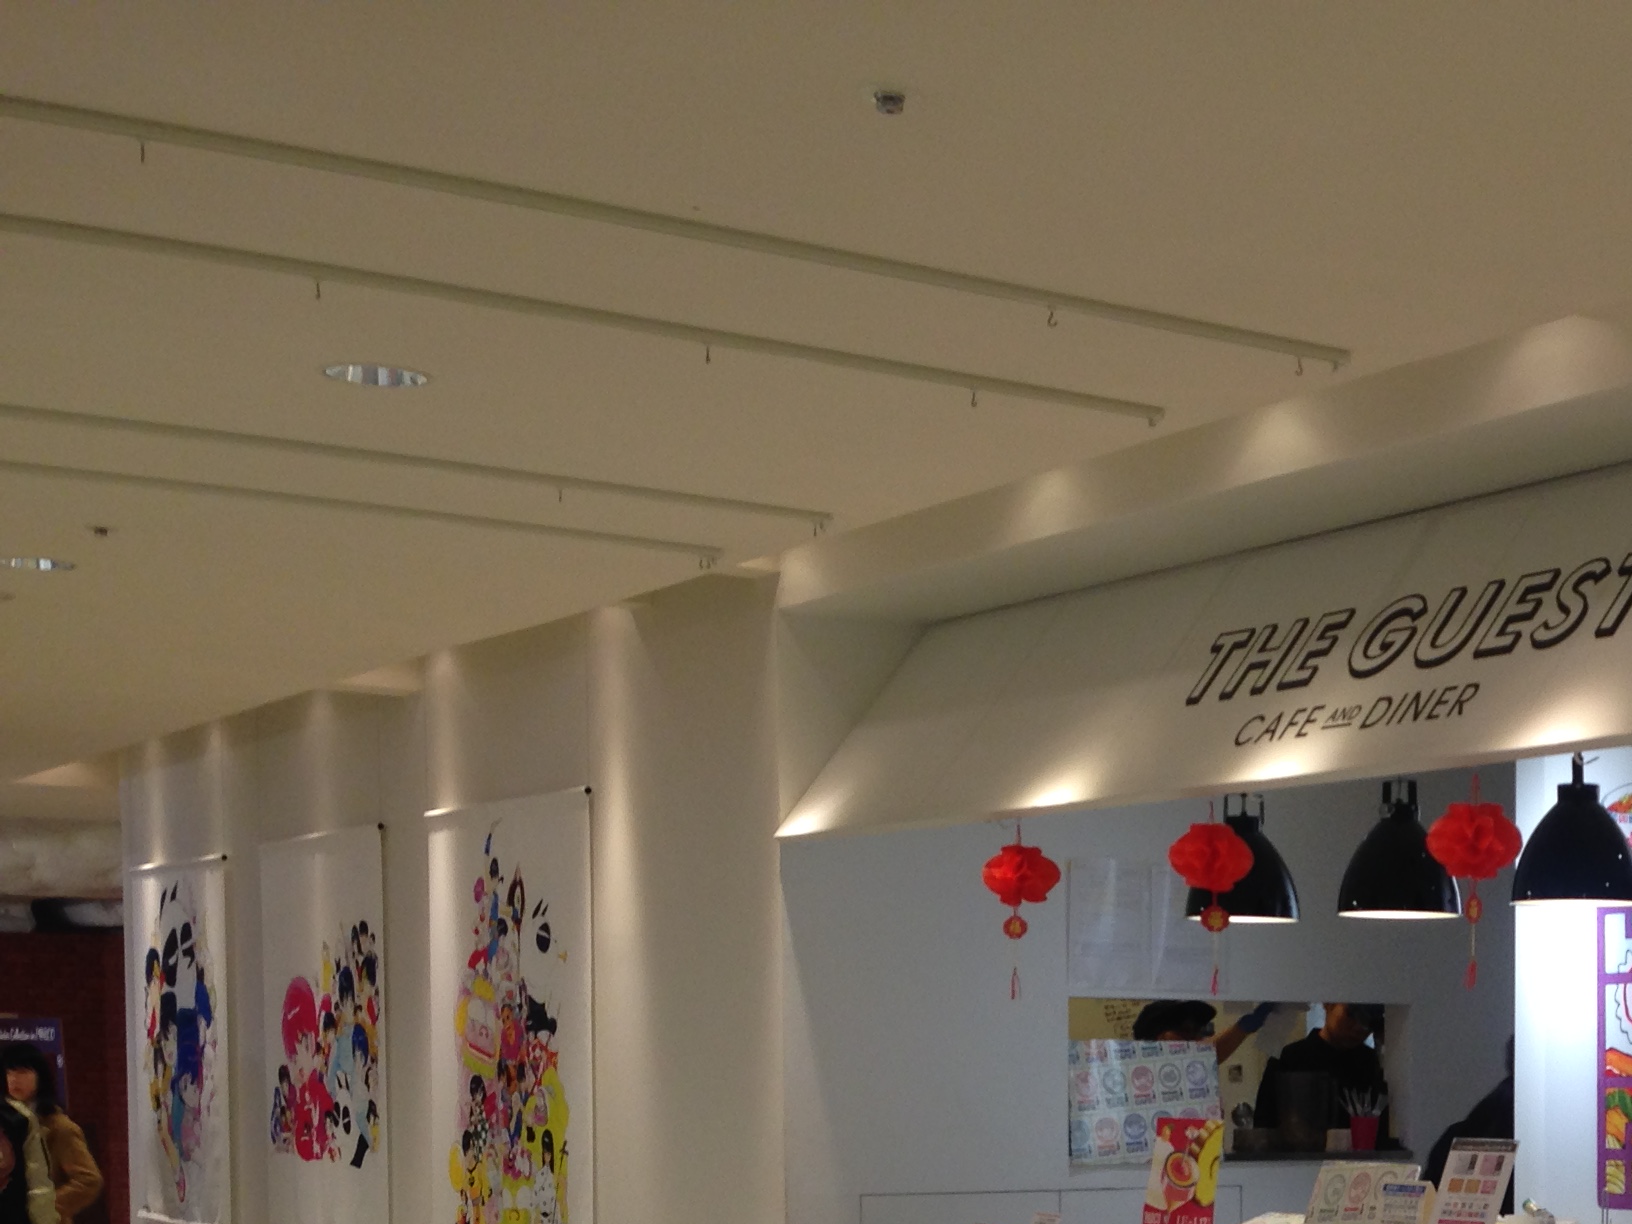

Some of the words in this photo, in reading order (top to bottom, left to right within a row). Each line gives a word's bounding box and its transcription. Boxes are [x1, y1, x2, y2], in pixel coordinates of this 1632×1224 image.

[1186, 606, 1357, 706] THE
[1234, 703, 1326, 748] CAFE
[1322, 703, 1363, 728] AND
[1359, 682, 1481, 731] DINER
